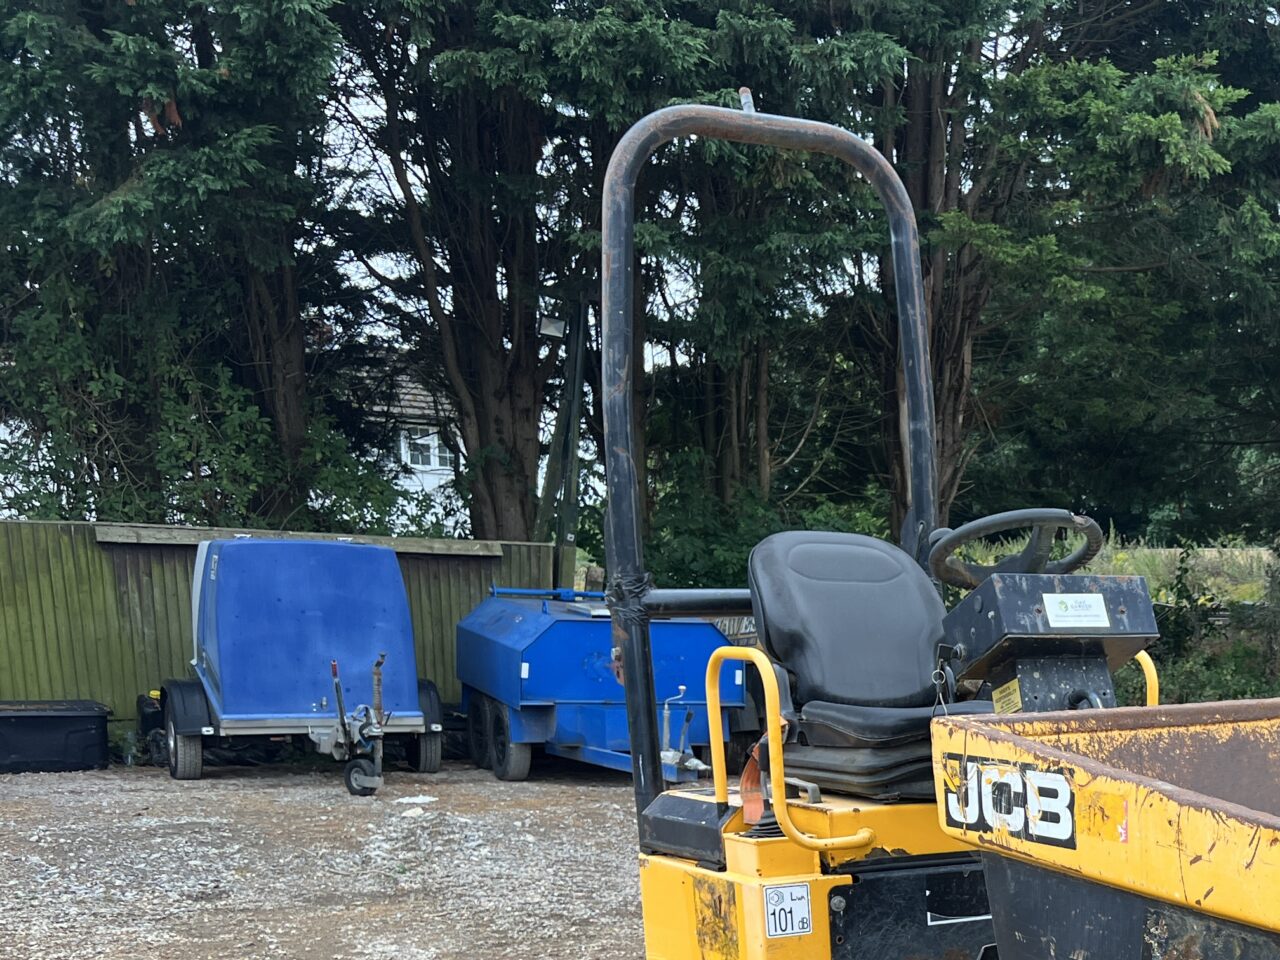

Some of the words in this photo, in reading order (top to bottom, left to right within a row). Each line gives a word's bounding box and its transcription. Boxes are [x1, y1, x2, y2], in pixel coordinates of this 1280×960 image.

[947, 761, 1073, 840] JCB
[770, 907, 794, 933] 101
[798, 917, 809, 931] dB
